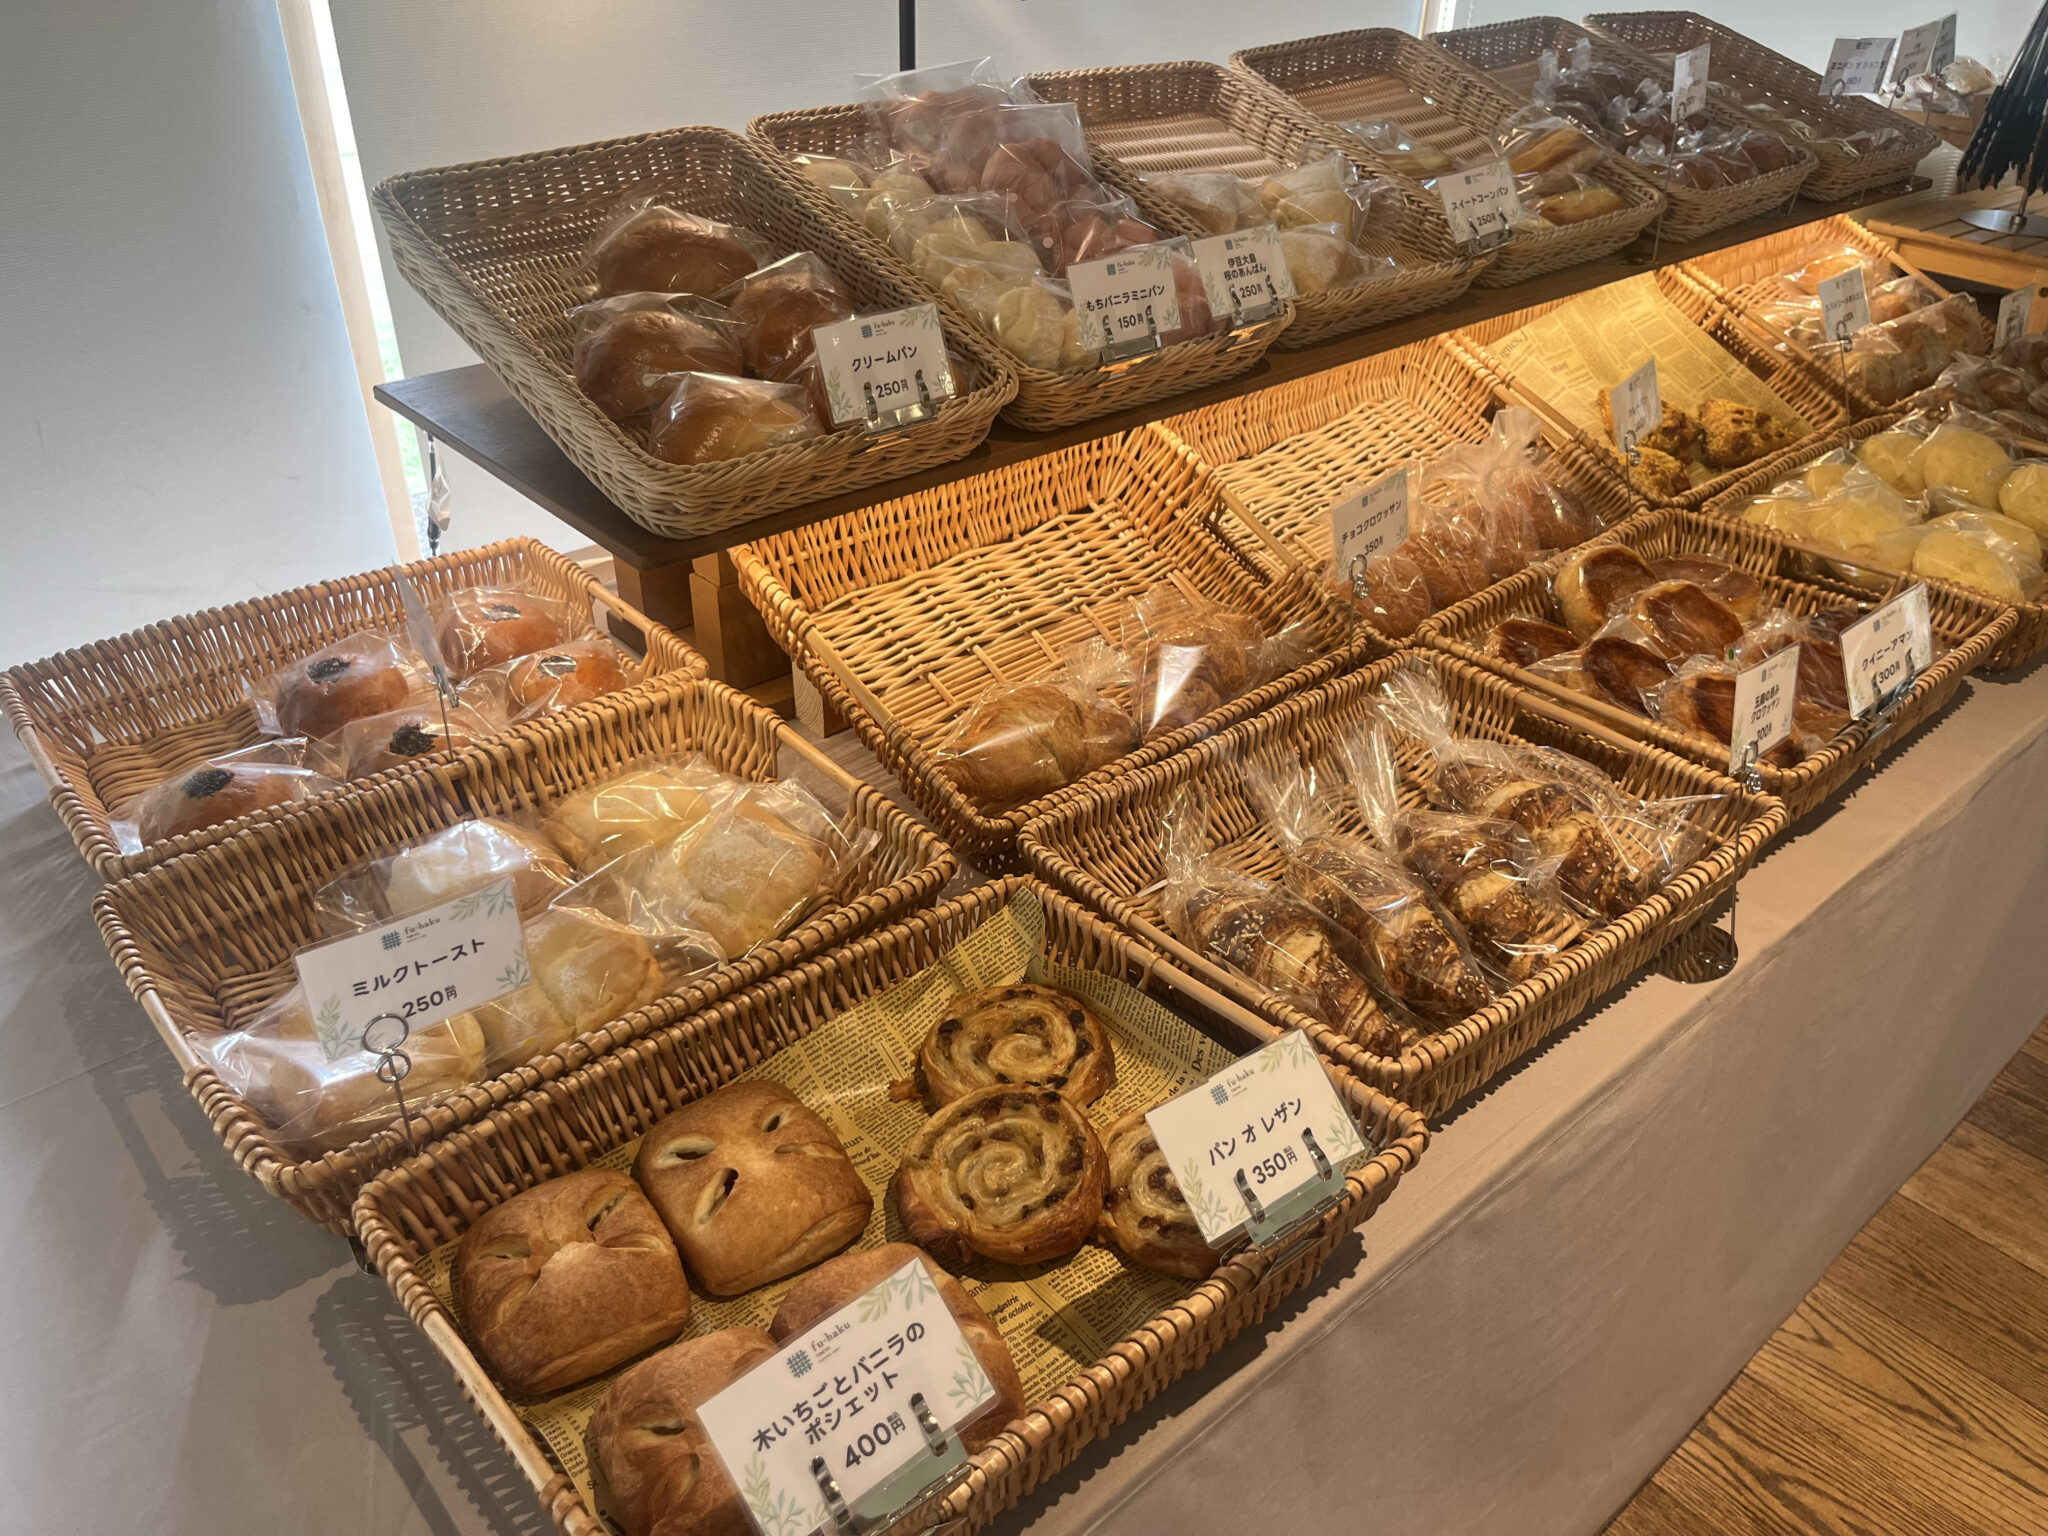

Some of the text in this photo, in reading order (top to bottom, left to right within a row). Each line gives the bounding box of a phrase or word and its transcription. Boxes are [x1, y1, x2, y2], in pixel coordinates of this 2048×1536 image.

[1451, 187, 1509, 210] スイートコーンパン
[1227, 253, 1257, 268] 伊豆大島
[852, 346, 917, 372] クリームパン
[1341, 500, 1402, 544] チョコクロワッサン
[1751, 697, 1781, 724] クロワッサン
[404, 917, 441, 936] fu-haku
[352, 938, 485, 997] ミルクトースト
[1227, 1067, 1255, 1088] fu-haku
[1208, 1098, 1302, 1166] パン オ レザン
[811, 1321, 851, 1353] fu-haku
[752, 1322, 925, 1452] 木いちごとバニラの
[844, 1411, 906, 1470] 400円
